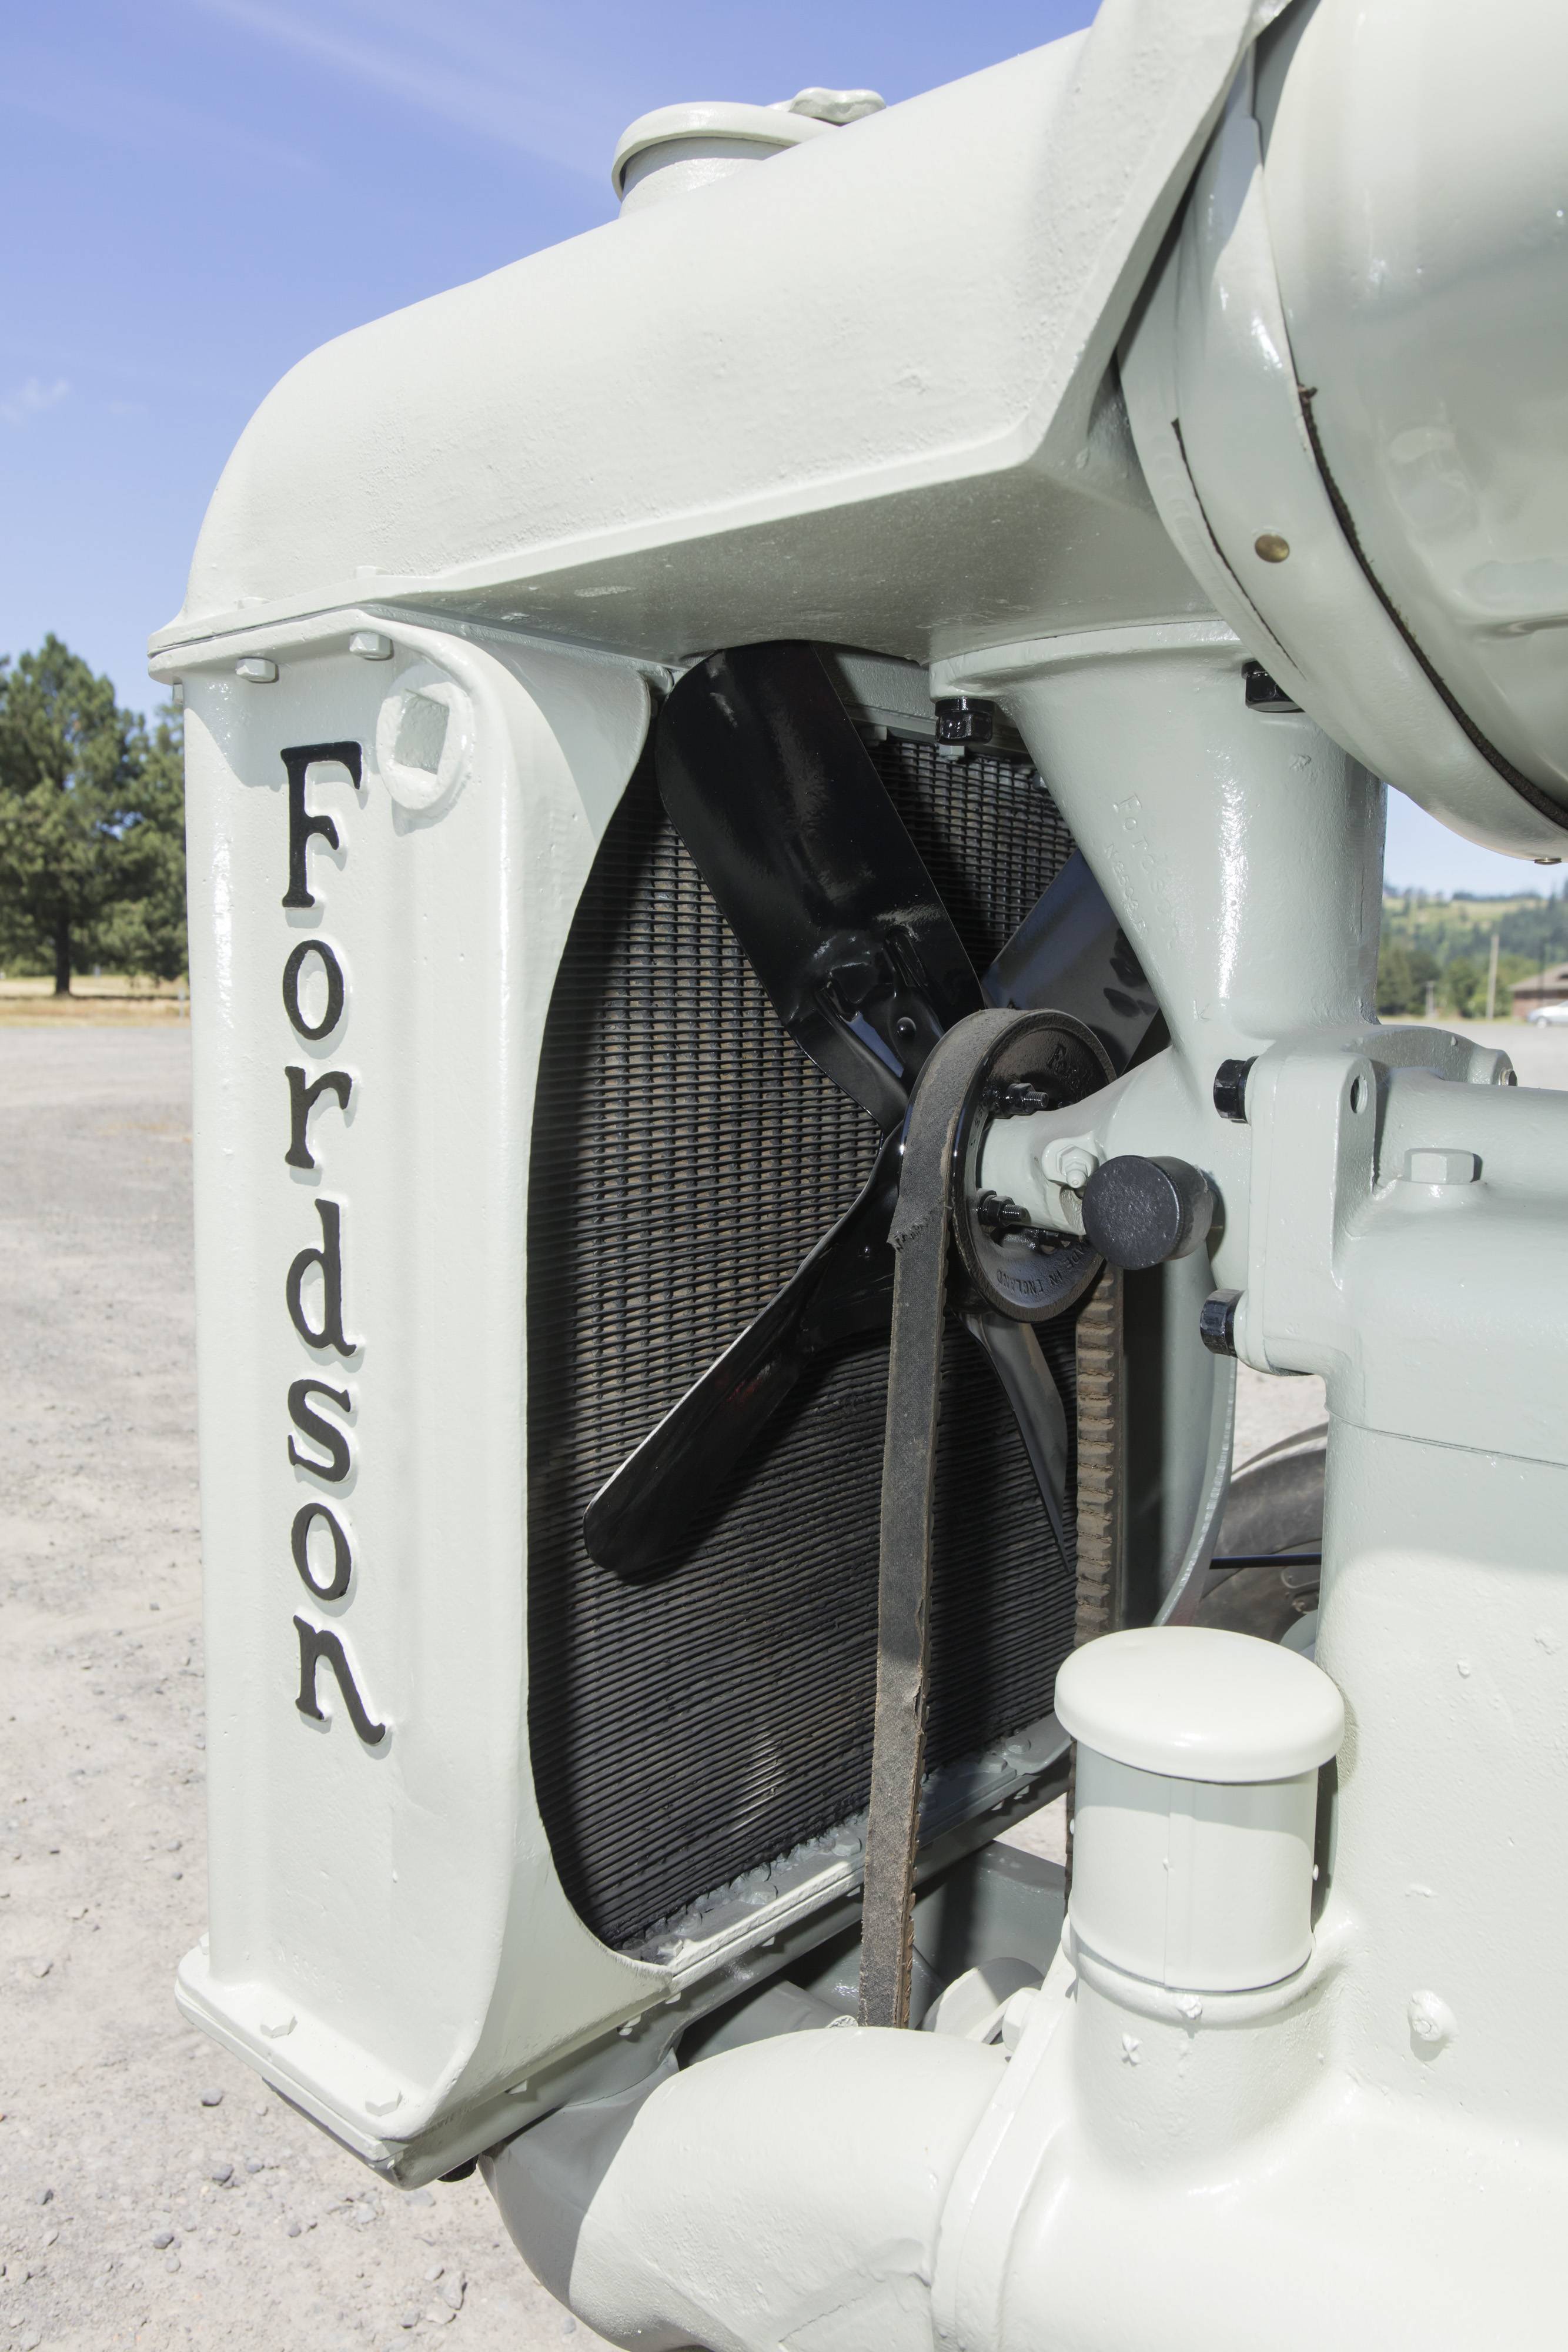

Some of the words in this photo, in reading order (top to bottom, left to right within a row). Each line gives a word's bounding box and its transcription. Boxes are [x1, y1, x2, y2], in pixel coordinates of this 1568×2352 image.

[279, 740, 387, 1746] Fordson
[997, 1268, 1044, 1296] ENGLAND
[1048, 1269, 1064, 1287] IN
